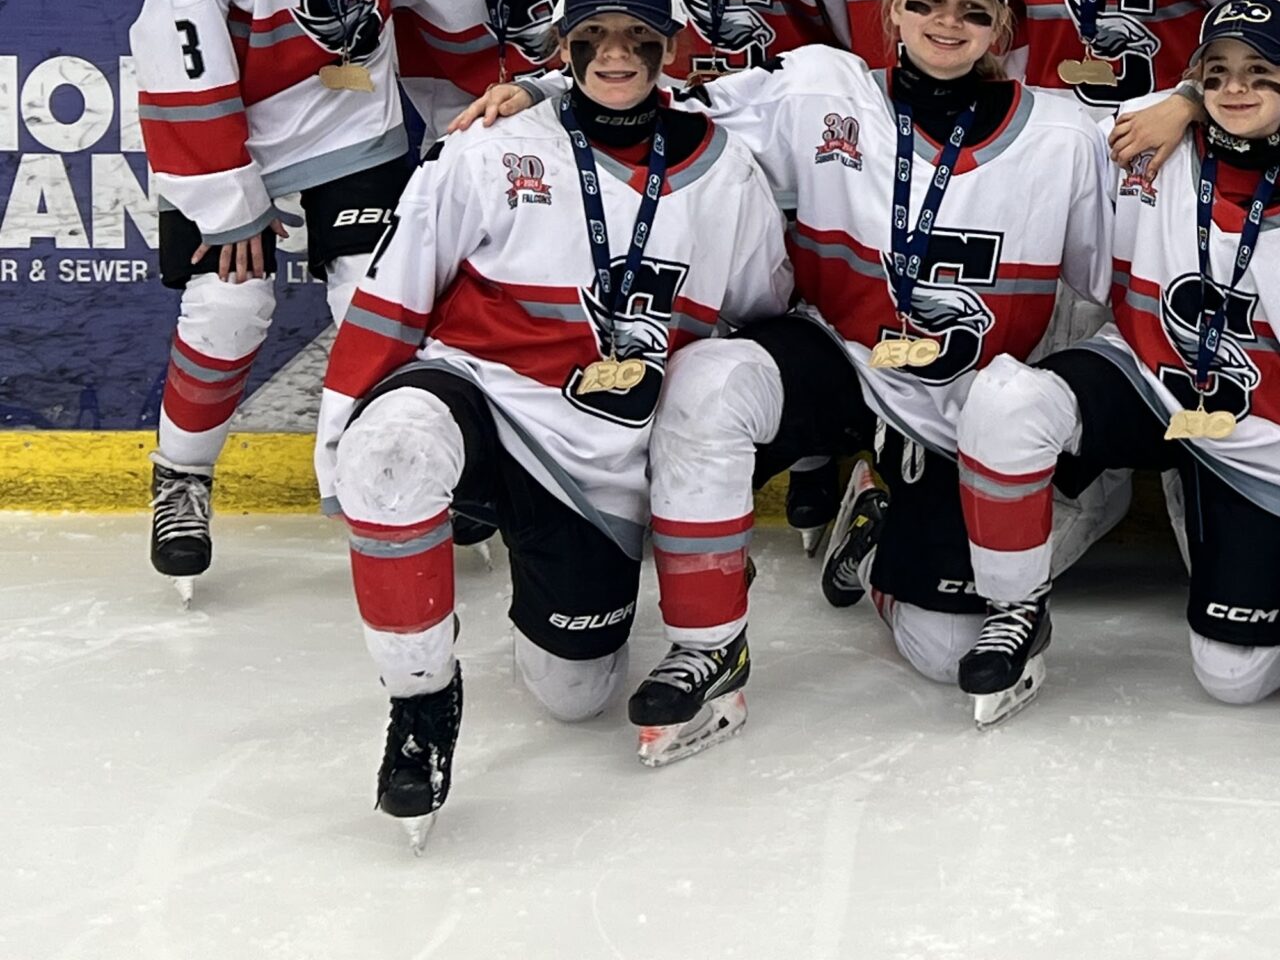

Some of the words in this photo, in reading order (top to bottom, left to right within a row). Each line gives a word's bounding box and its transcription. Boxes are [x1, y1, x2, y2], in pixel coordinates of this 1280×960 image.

[1213, 0, 1272, 25] BC
[174, 19, 205, 80] 3
[29, 260, 46, 282] &
[58, 259, 148, 282] SEWER
[287, 260, 324, 283] LT
[1206, 601, 1280, 624] CCM
